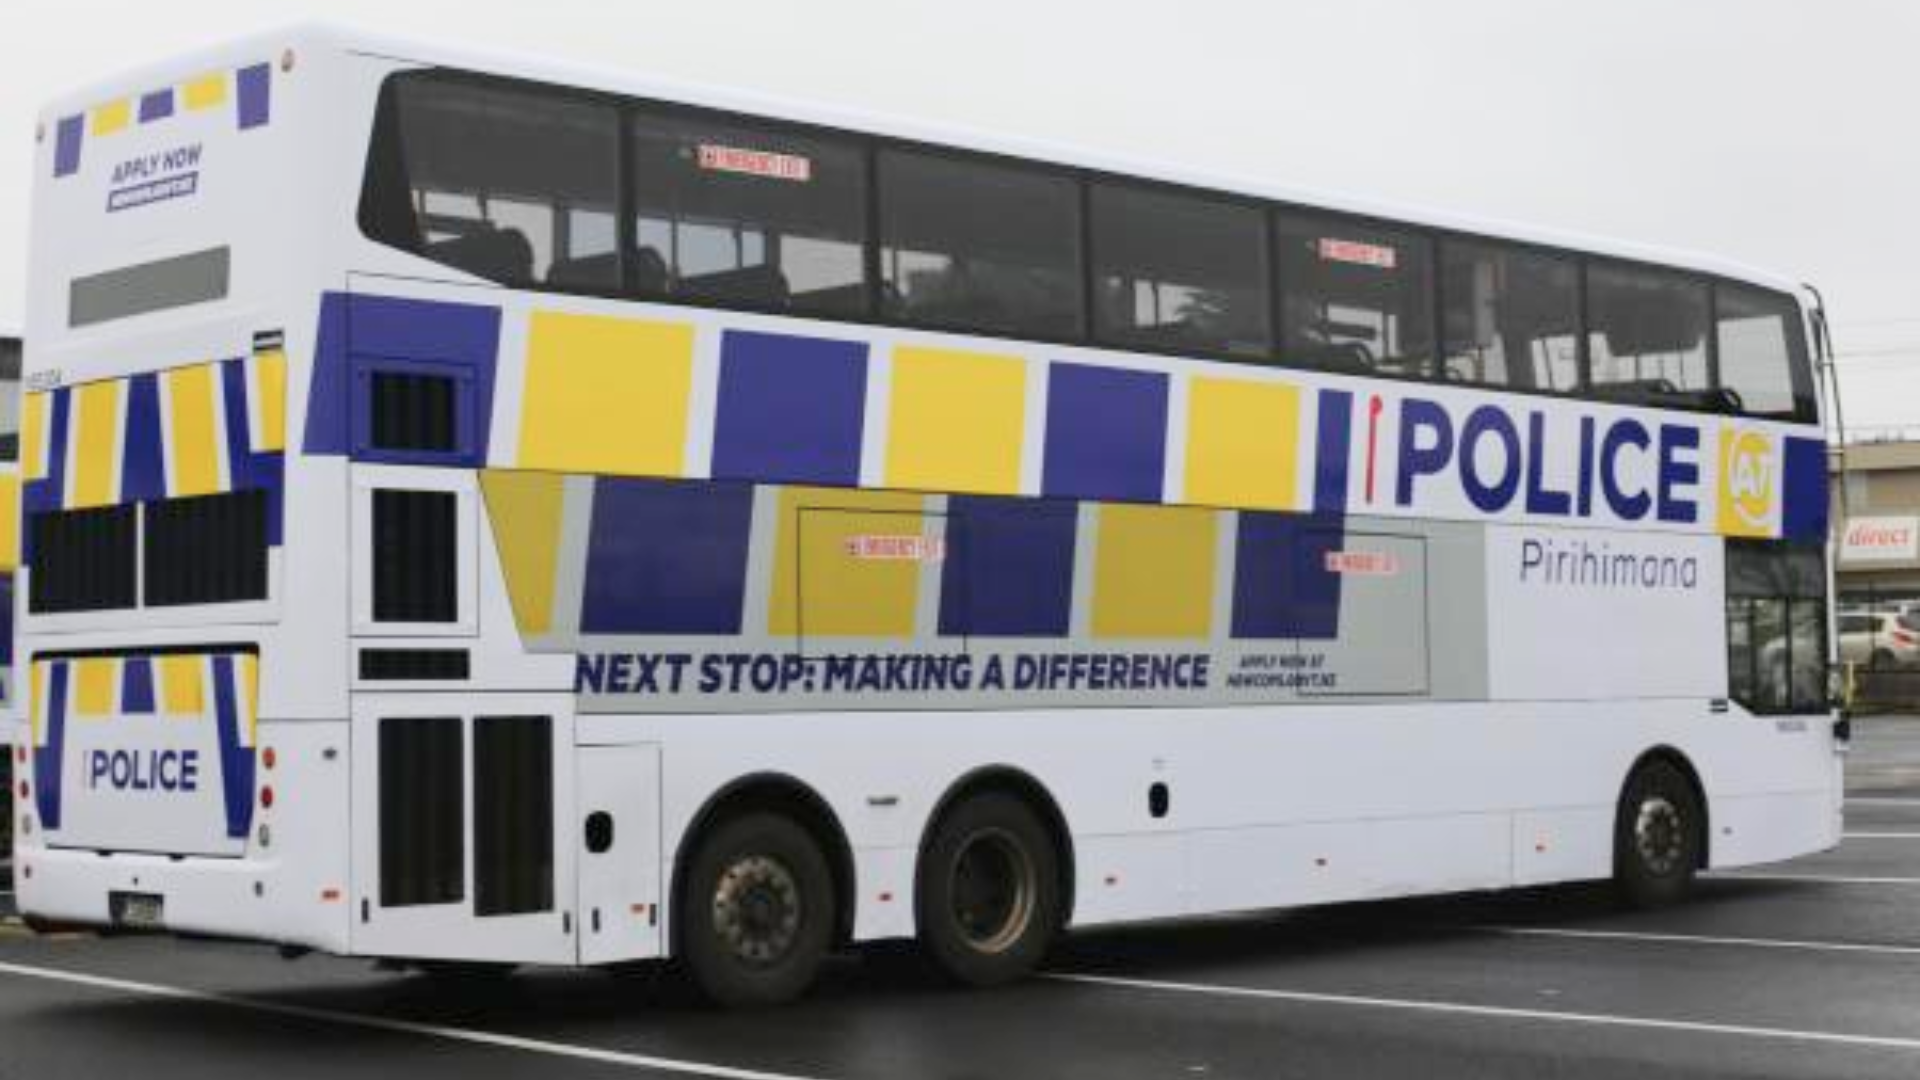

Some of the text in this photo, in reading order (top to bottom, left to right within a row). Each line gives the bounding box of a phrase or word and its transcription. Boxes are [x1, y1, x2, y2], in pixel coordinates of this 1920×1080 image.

[163, 141, 202, 171] NOW
[1396, 398, 1700, 523] POLICE
[1847, 525, 1909, 548] direct
[1520, 540, 1697, 588] Pirihimana
[575, 653, 1210, 694] NEXT STOP: MAKING A DIFFERENCE
[91, 748, 200, 793] POLICE
